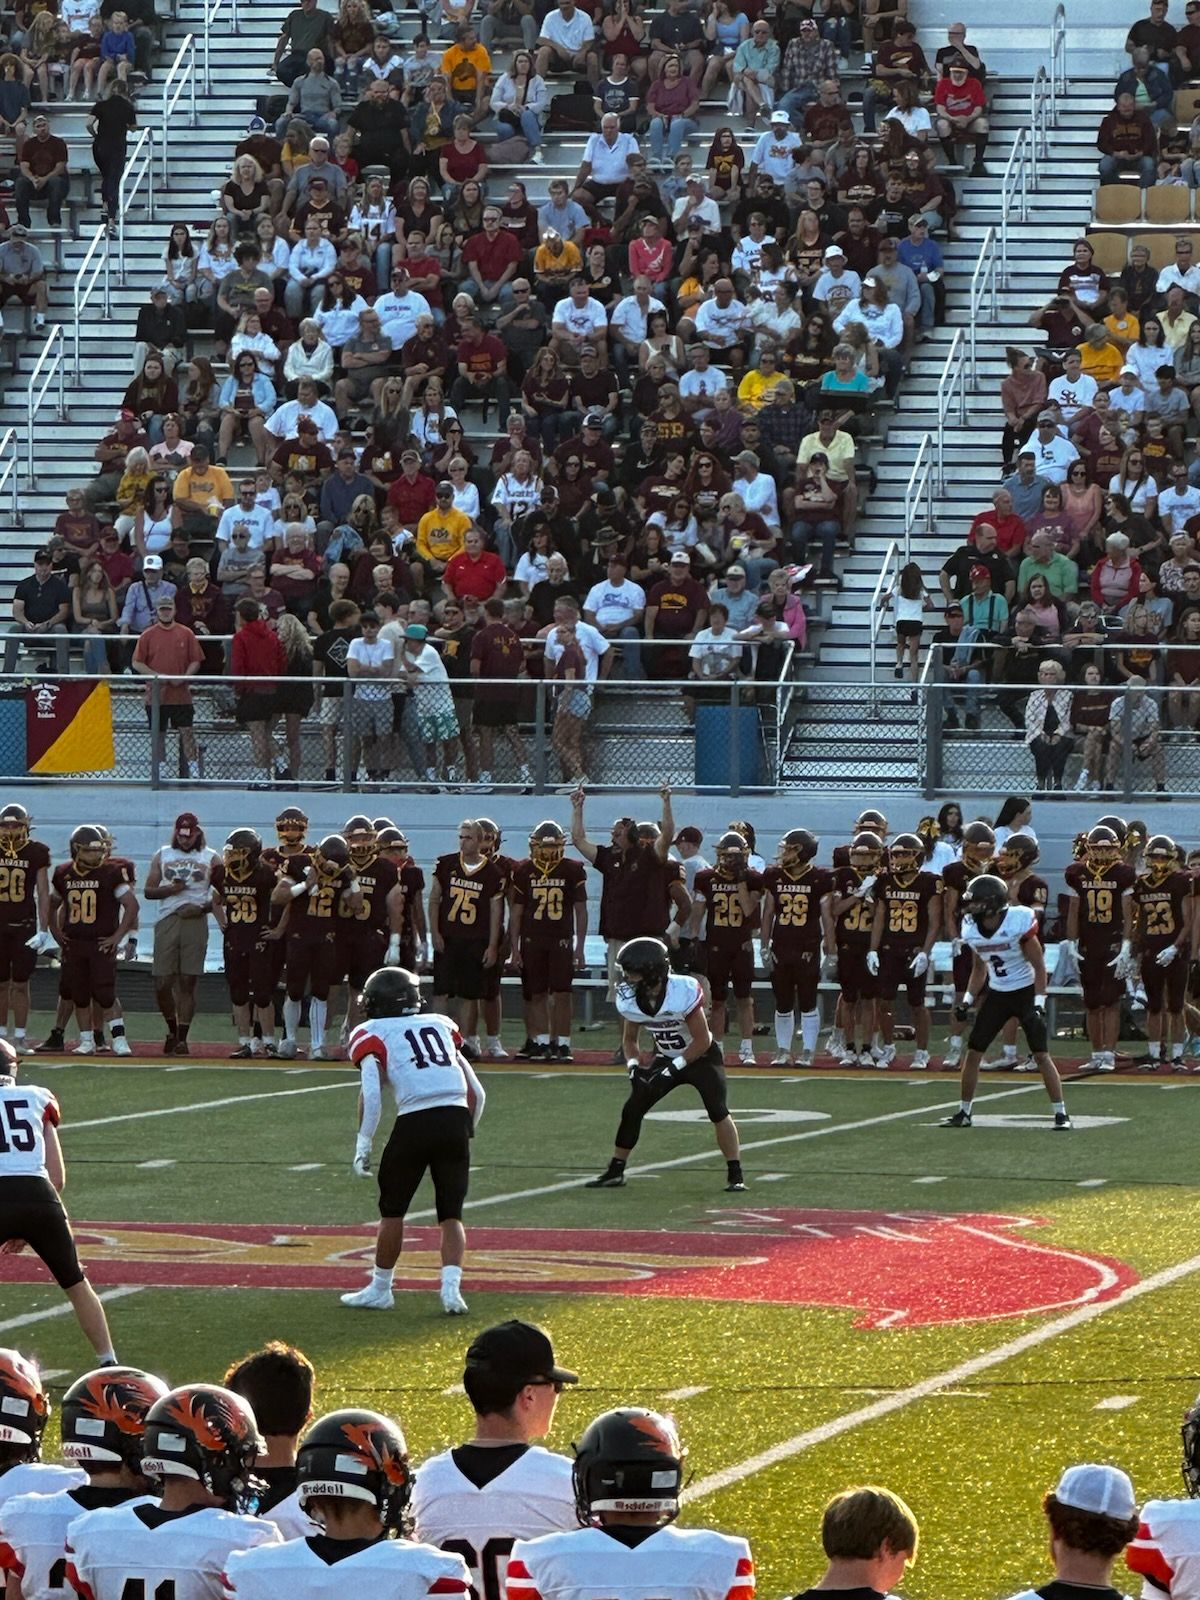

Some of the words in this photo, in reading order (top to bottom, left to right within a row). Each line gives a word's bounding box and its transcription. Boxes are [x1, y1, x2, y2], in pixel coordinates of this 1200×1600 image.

[0, 867, 26, 902] 20
[68, 889, 97, 924] 60
[227, 895, 257, 924] 30
[447, 886, 480, 925] 75
[532, 888, 564, 921] 70
[1086, 889, 1113, 923] 19
[1143, 901, 1176, 935] 23
[989, 954, 1008, 977] 2
[404, 1026, 452, 1070] 10
